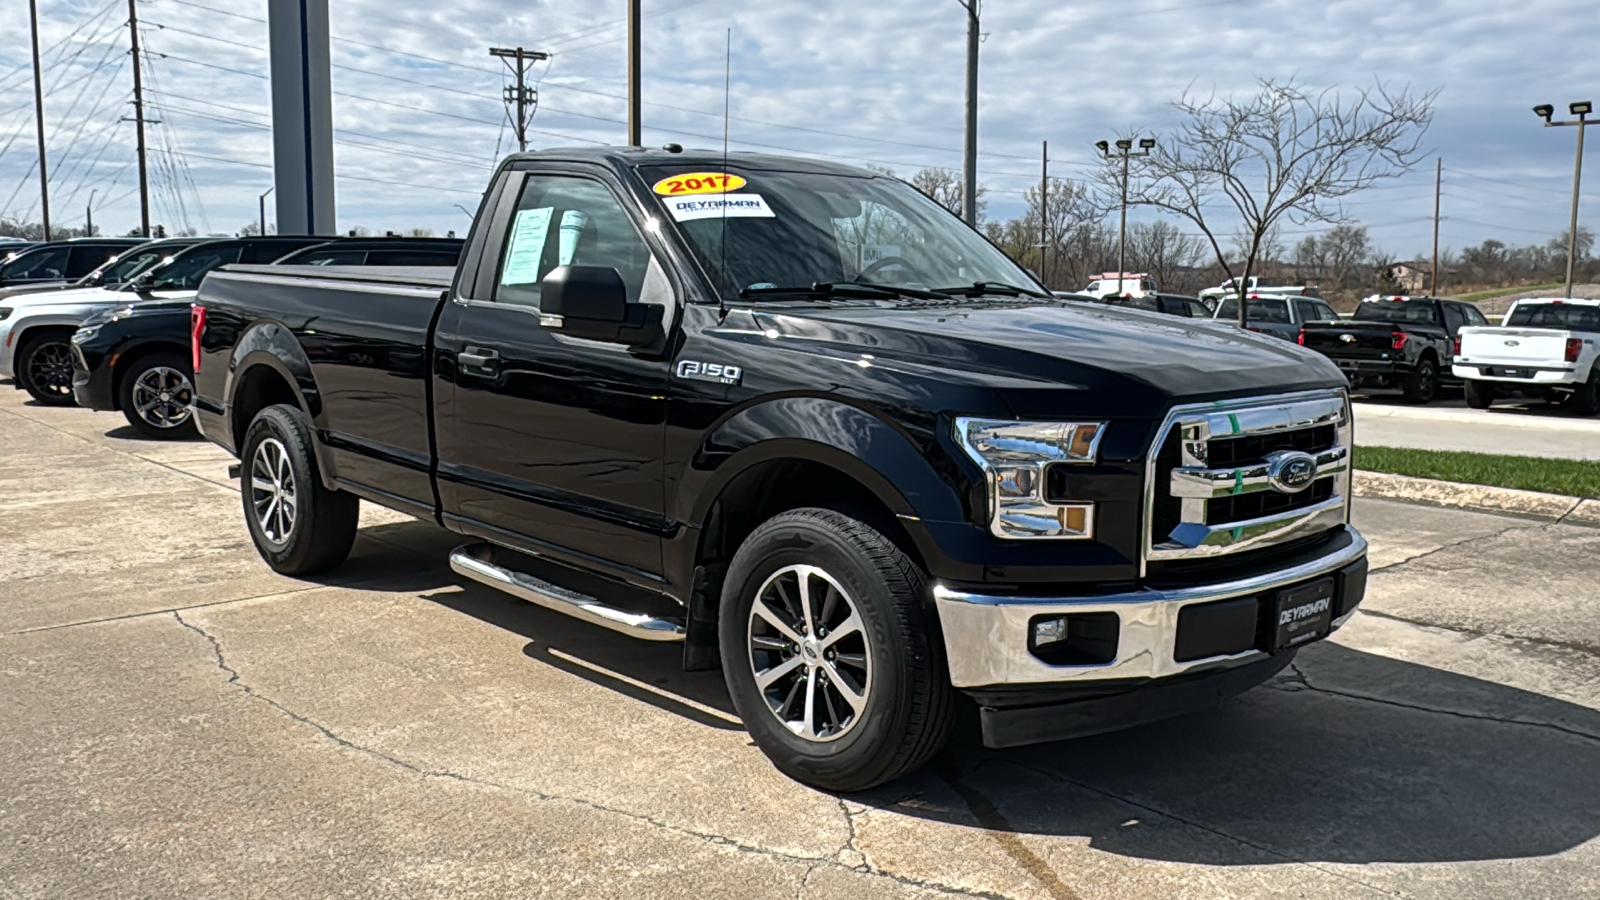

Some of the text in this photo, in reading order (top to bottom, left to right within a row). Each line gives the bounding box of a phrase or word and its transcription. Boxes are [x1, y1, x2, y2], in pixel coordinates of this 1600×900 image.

[666, 176, 732, 193] 2017
[676, 200, 761, 211] DEYARMAN
[1287, 462, 1312, 484] Ford
[1279, 597, 1331, 626] DEYARMAN
